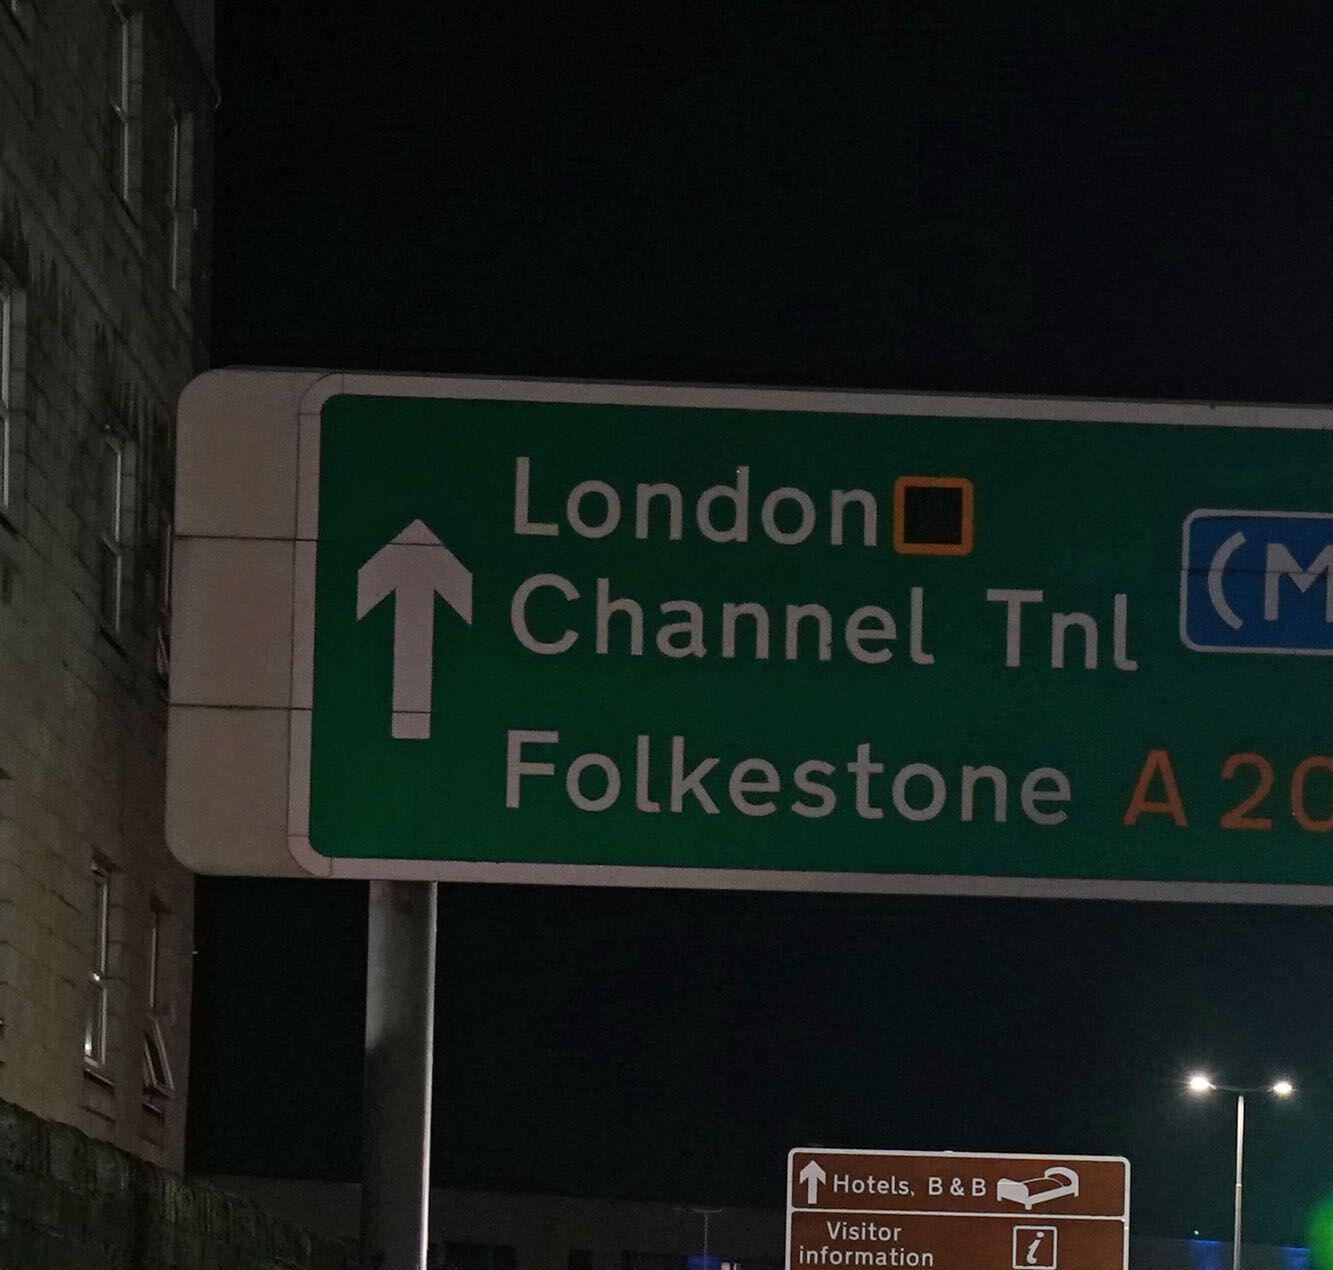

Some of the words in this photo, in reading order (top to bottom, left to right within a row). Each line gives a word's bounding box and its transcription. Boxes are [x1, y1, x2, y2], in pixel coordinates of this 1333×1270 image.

[513, 455, 879, 547] London
[509, 572, 936, 666] Channel
[985, 587, 1139, 672] Tnl
[504, 728, 1072, 826] Folkestone
[799, 1245, 934, 1267] information
[826, 1220, 902, 1242] Visitor
